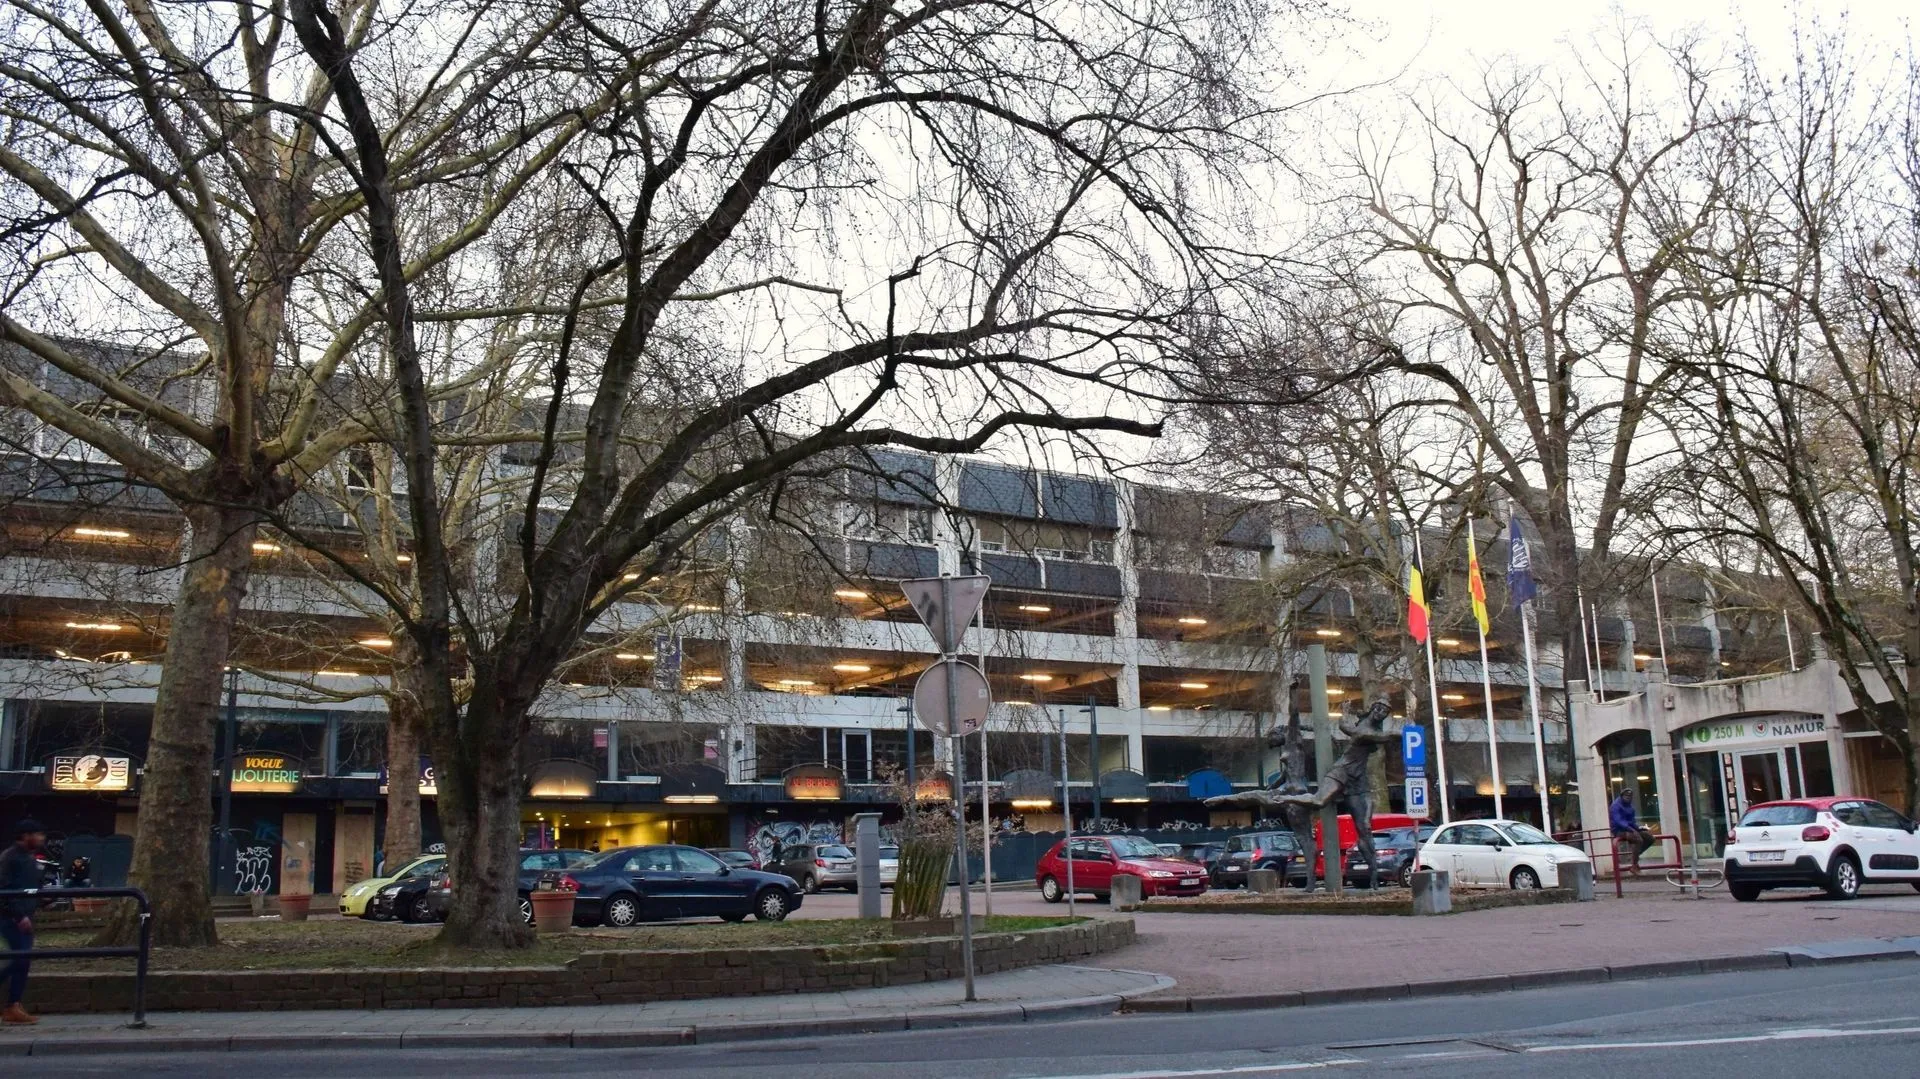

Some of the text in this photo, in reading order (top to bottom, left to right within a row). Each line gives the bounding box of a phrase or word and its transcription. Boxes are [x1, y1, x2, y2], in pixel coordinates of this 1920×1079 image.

[1714, 727, 1733, 739] 250
[1735, 724, 1745, 737] M
[1772, 721, 1825, 737] NAMUR
[1405, 731, 1422, 759] P
[56, 758, 74, 783] SIDE
[245, 757, 284, 769] VOGUE
[232, 769, 299, 783] IJOUTERIE
[1413, 788, 1422, 804] P
